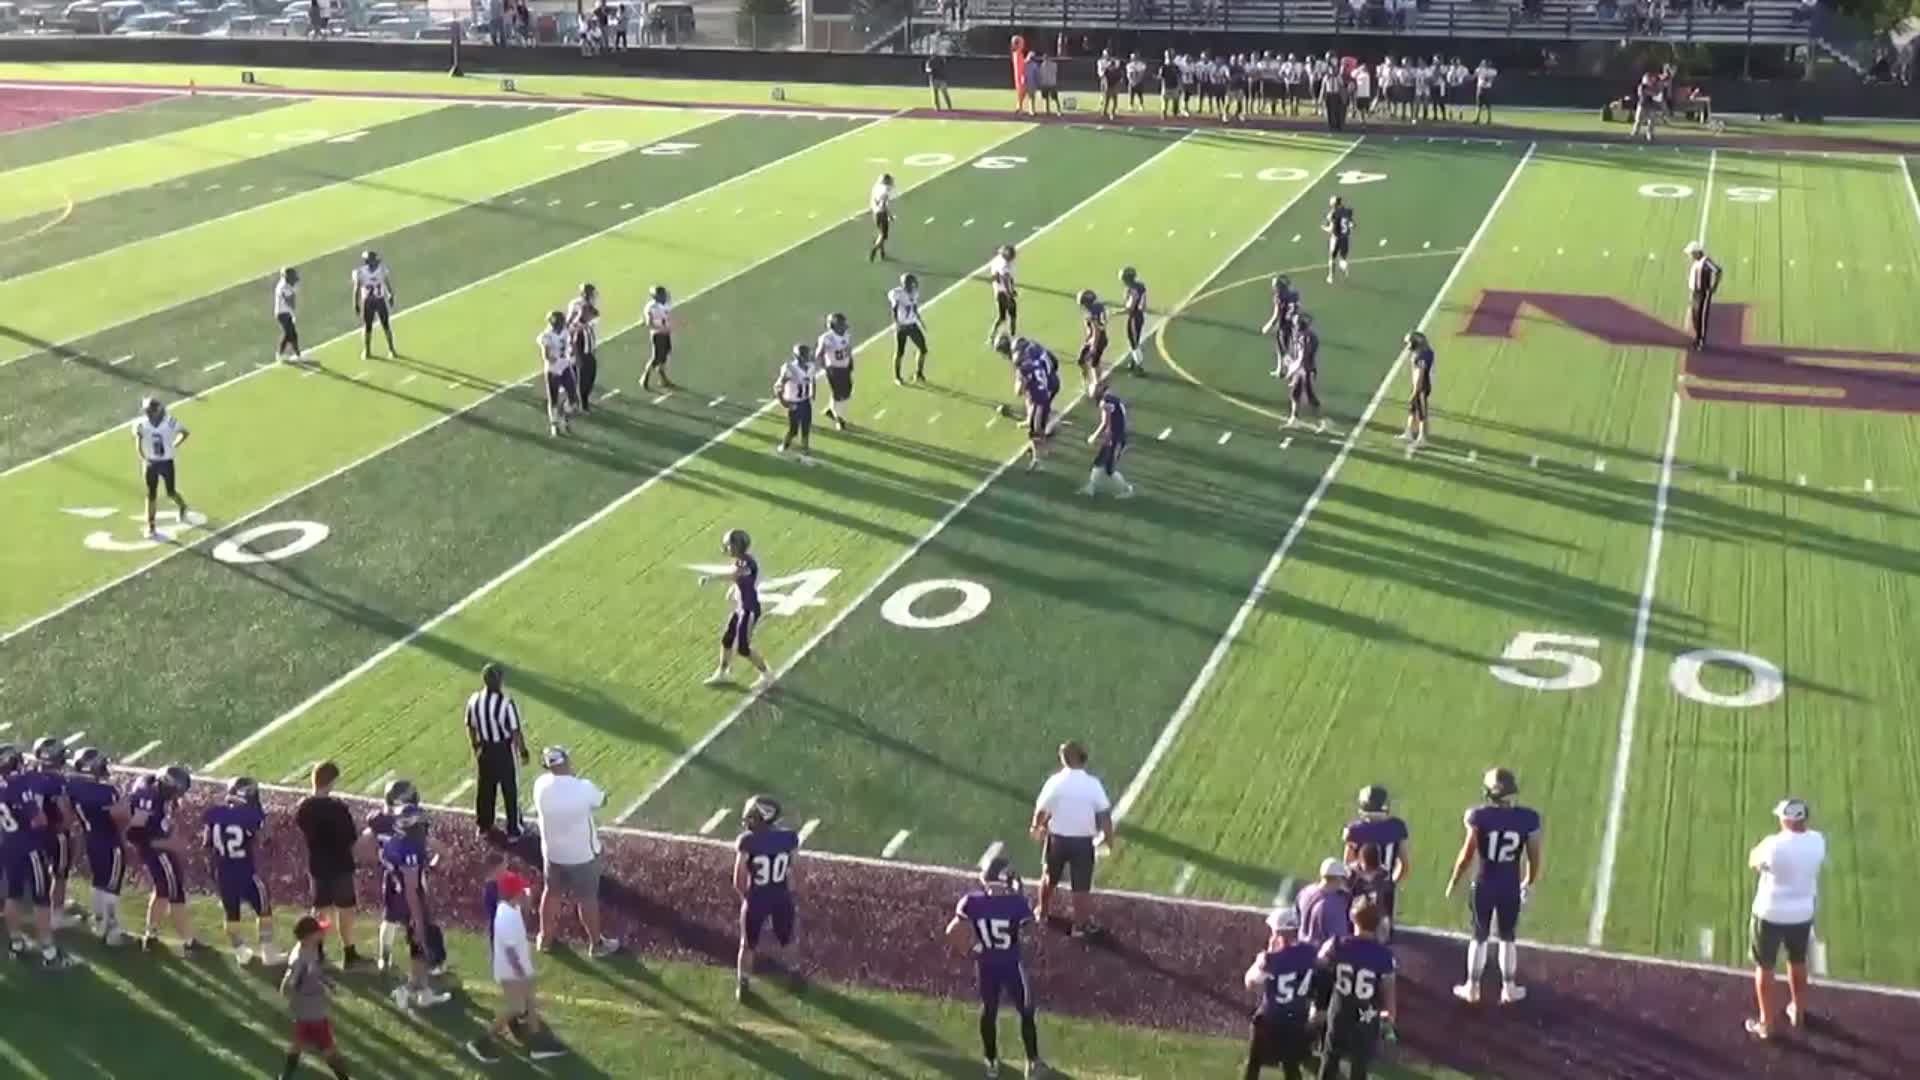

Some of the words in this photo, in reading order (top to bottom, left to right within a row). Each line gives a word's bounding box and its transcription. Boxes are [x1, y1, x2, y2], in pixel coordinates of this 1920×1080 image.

[1489, 632, 1784, 707] 50
[1487, 830, 1520, 863] 12
[752, 852, 789, 887] 30
[976, 917, 1012, 951] 15
